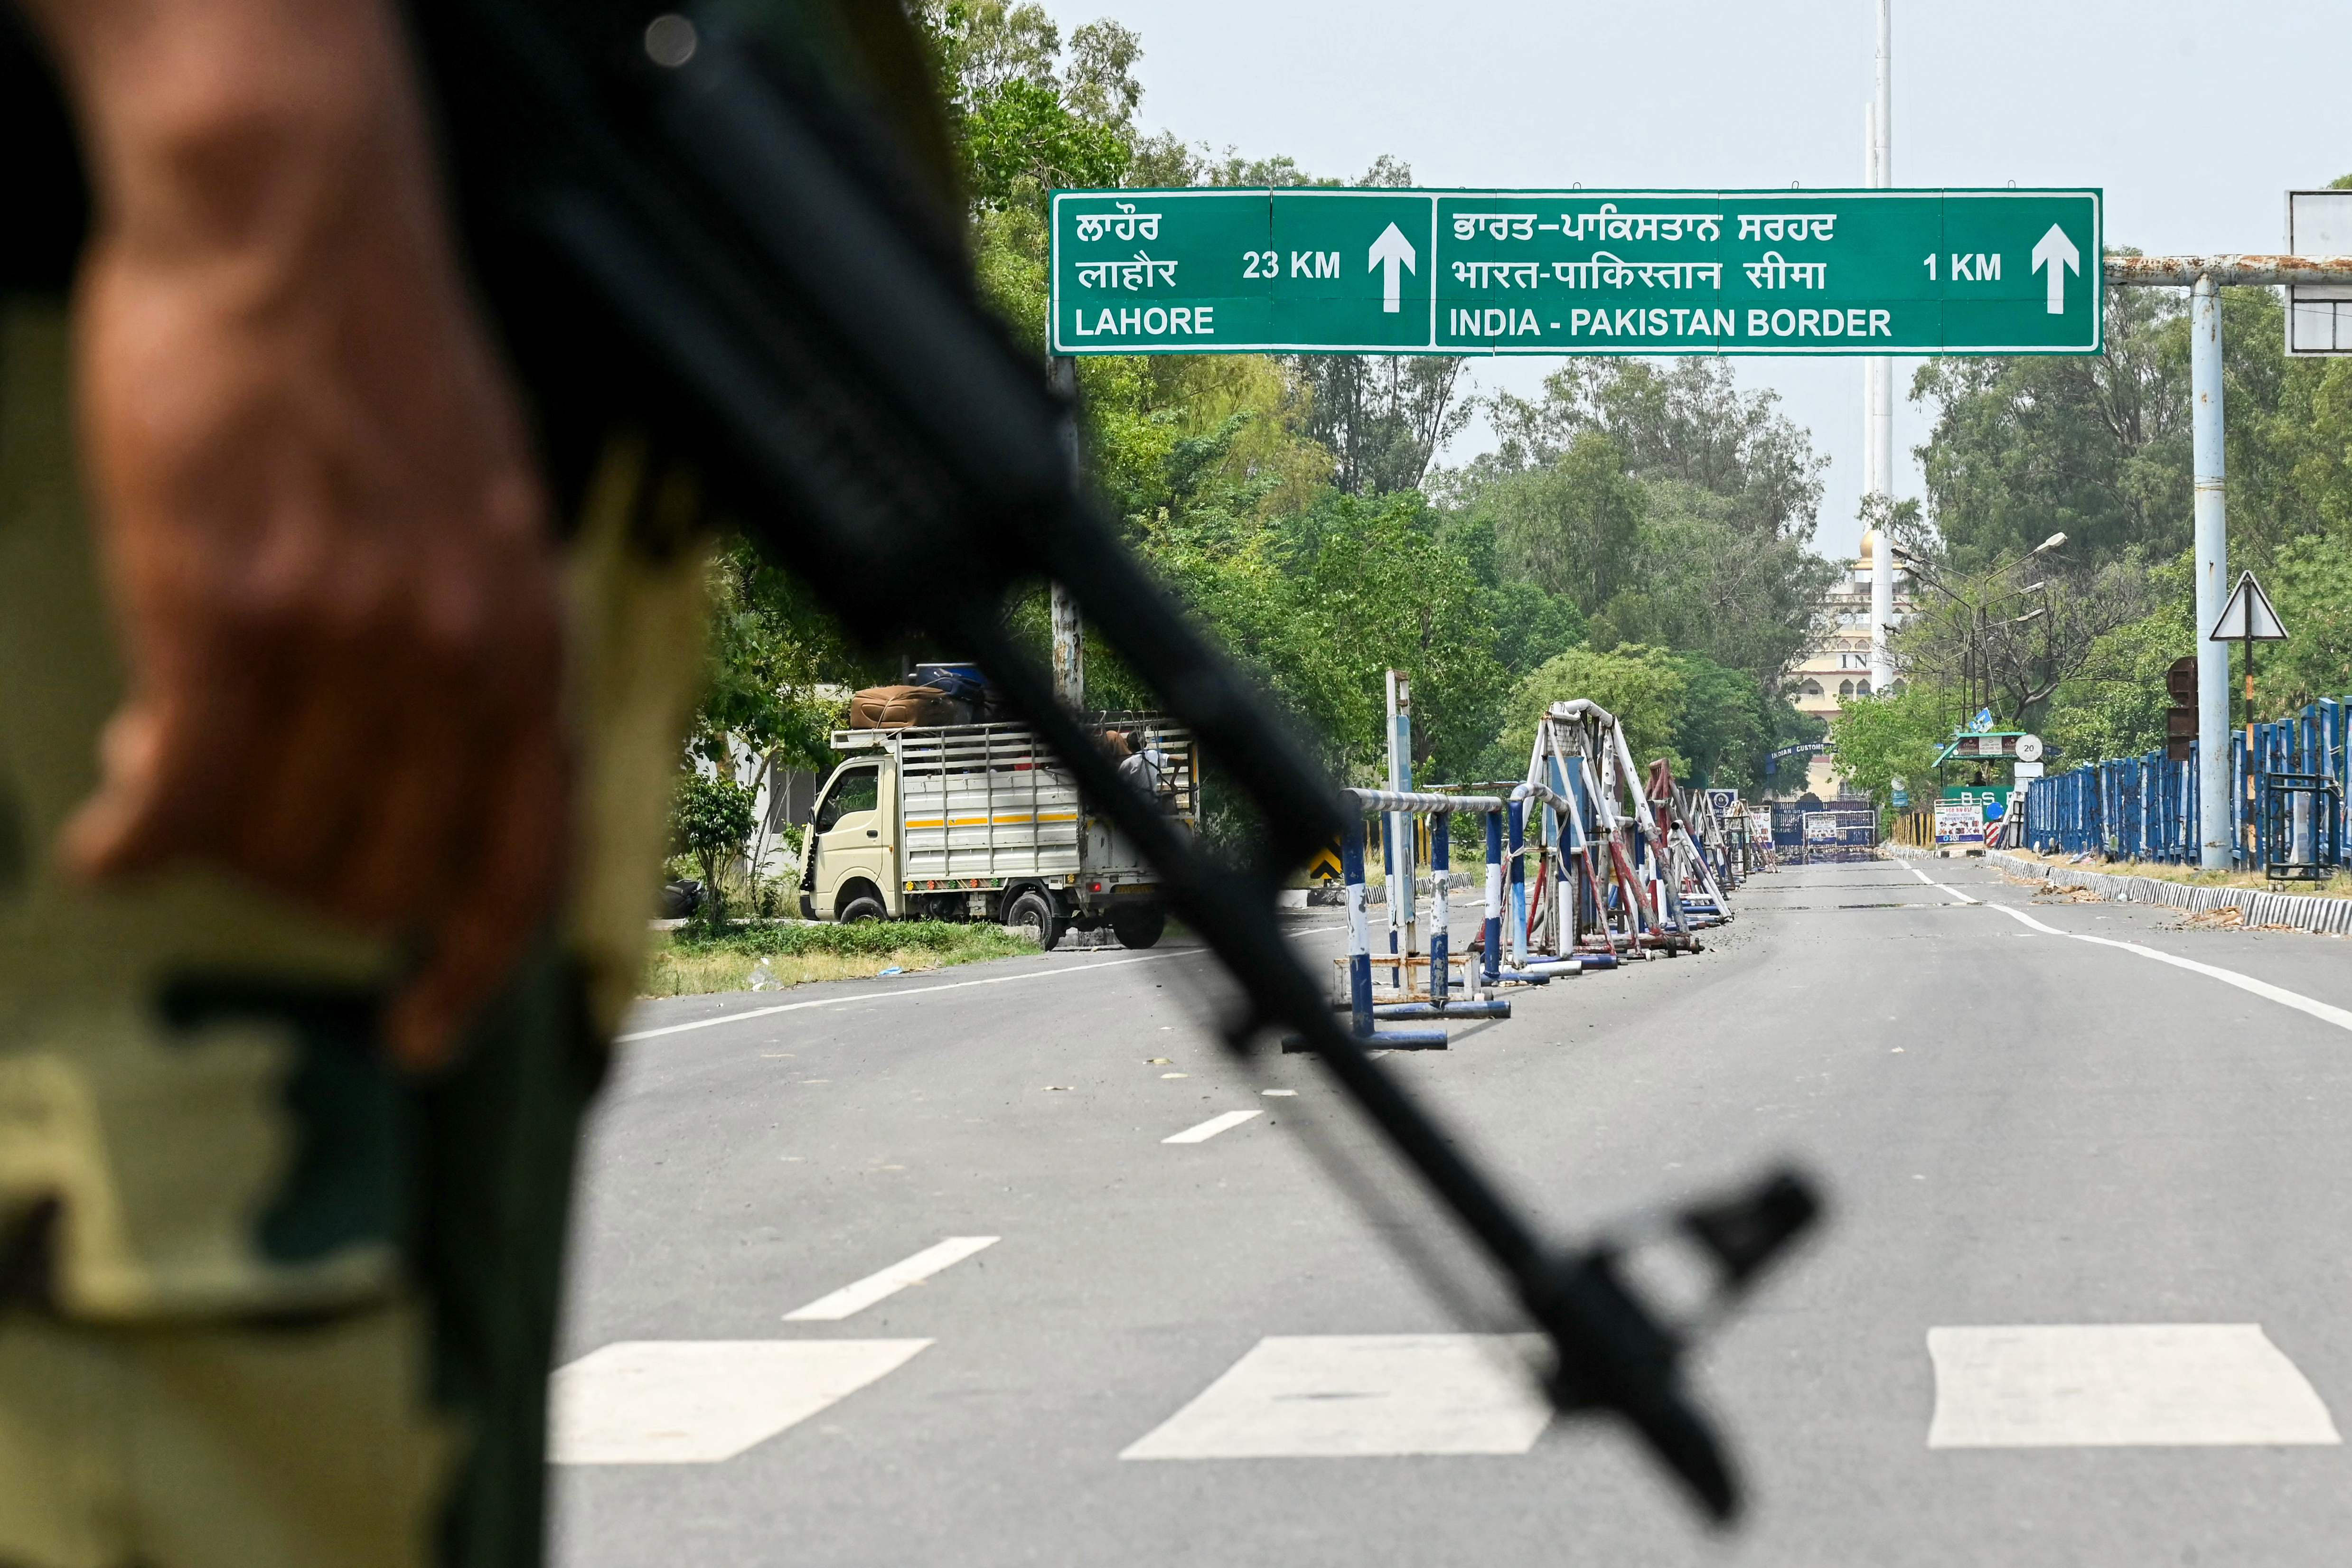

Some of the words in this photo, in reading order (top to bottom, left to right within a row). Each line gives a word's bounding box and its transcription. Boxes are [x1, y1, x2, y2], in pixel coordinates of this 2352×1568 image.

[1076, 202, 1162, 242] ਲਾਹੌਰ
[1737, 214, 1837, 241] ਸਰਹਦ
[1075, 250, 1178, 291] लाहौर
[1243, 251, 1279, 278] 23
[1291, 251, 1340, 278] KM
[1743, 251, 1827, 289] सीमा
[1924, 253, 1936, 280] 1
[1952, 253, 2001, 280] KM
[1076, 307, 1214, 336] LAHORE
[1451, 308, 1541, 336] INDIA
[1571, 308, 1735, 336] PAKISTAN
[1748, 309, 1892, 336] BORDER
[1771, 748, 1792, 759] INDIAN
[1796, 743, 1824, 752] CUSTOMS
